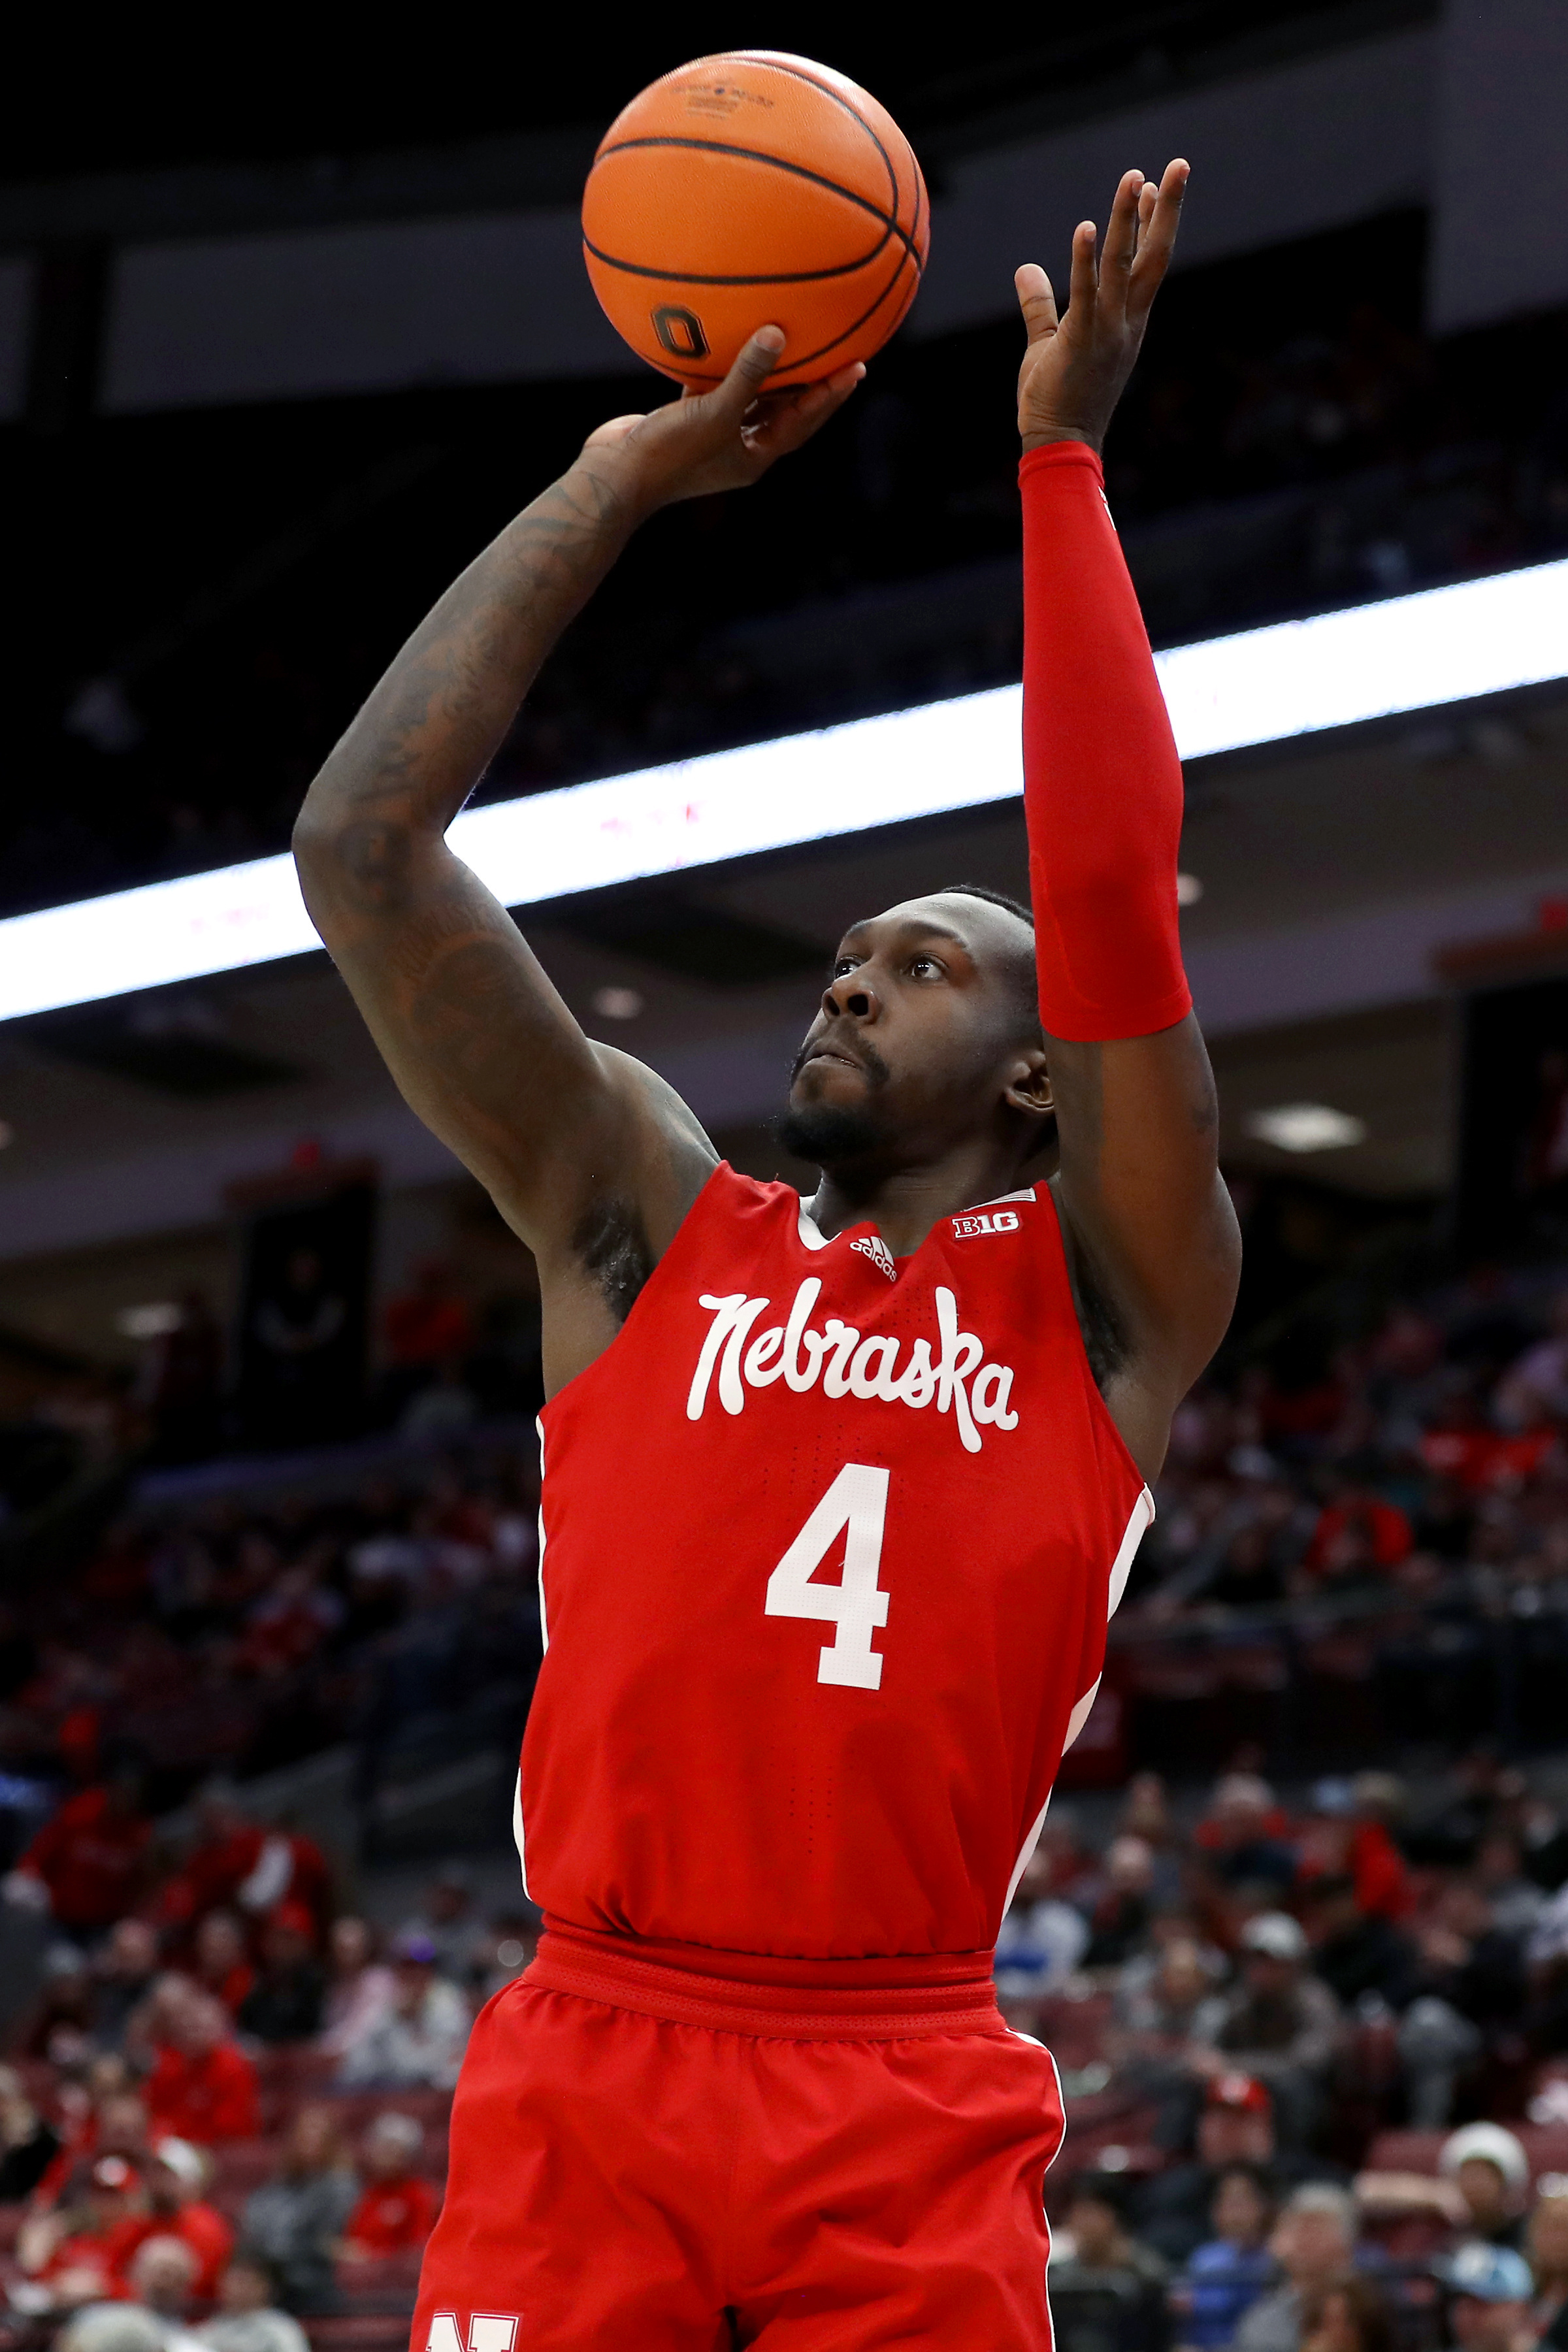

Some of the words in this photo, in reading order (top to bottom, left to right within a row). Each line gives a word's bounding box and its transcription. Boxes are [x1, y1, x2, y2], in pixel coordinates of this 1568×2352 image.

[849, 1241, 897, 1282] adidas
[686, 1277, 1020, 1454] Nebraska
[764, 1462, 890, 1691] 4
